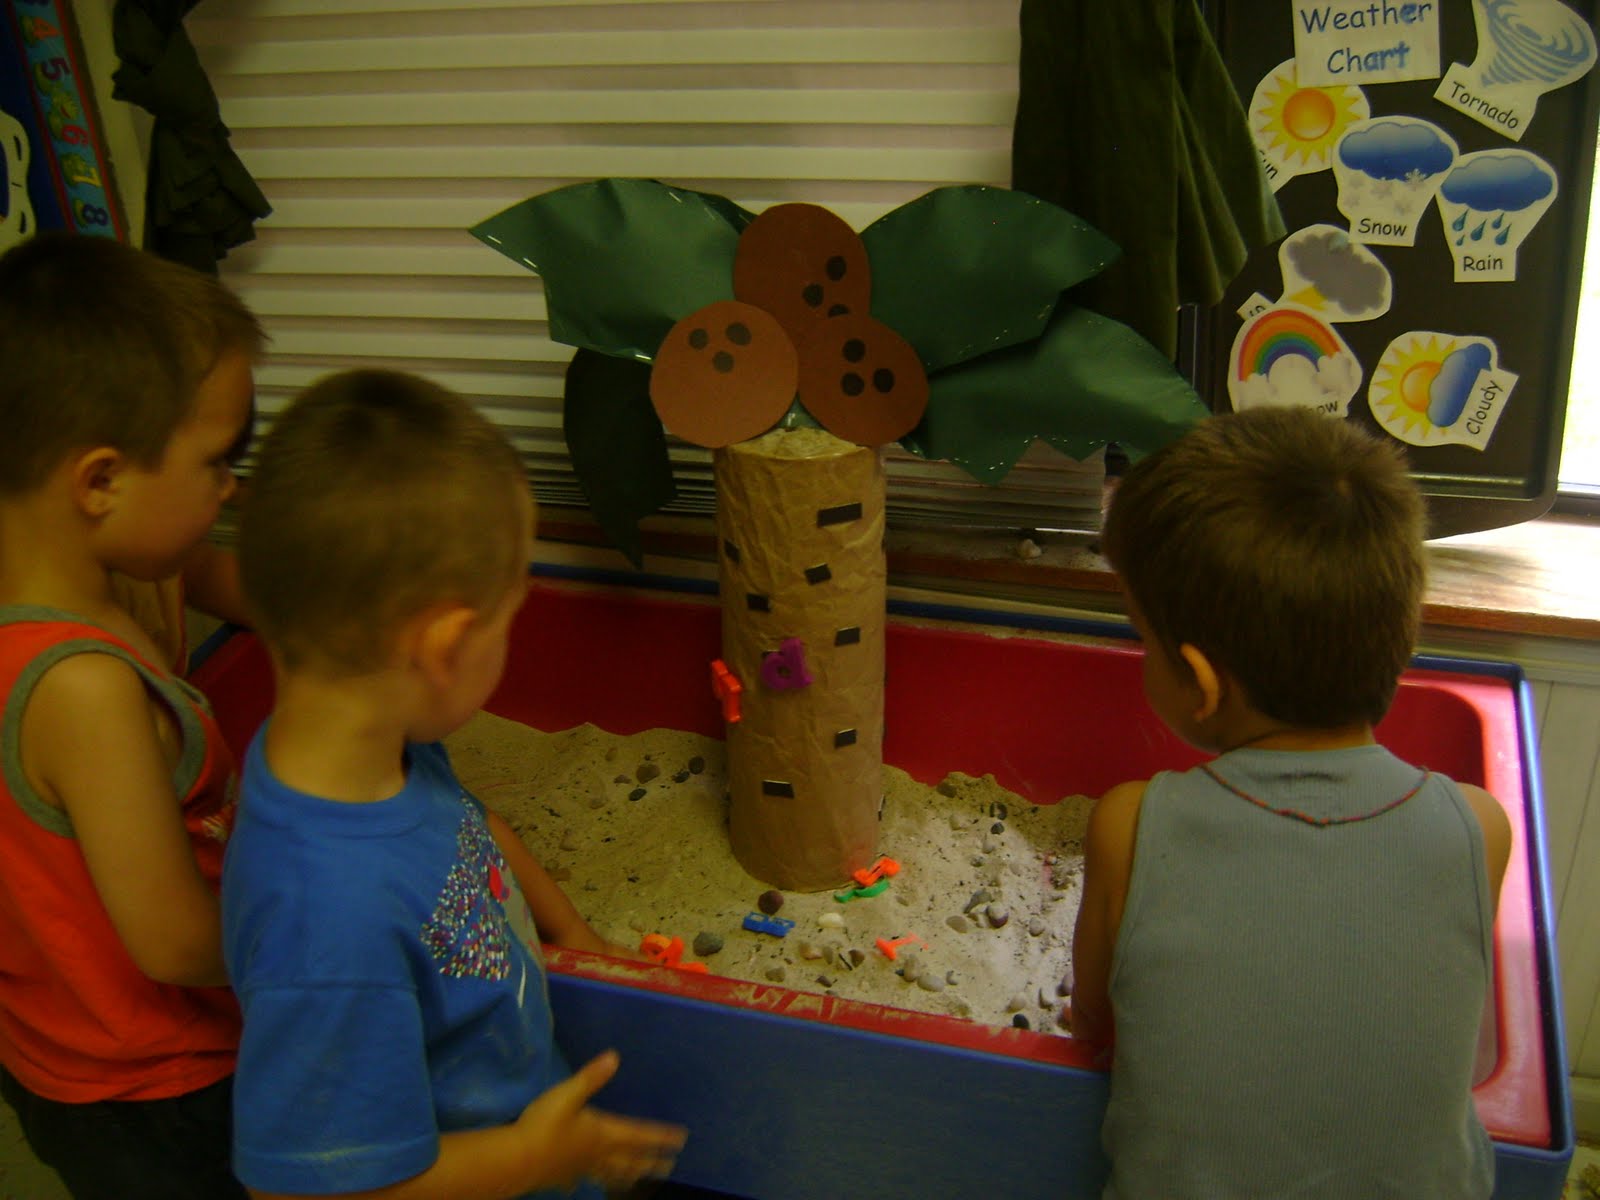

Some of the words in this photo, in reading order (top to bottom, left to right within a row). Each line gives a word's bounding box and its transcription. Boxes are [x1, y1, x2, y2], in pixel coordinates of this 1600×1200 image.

[32, 17, 61, 40] 4
[1300, 2, 1432, 34] Weather
[42, 57, 70, 80] 5
[1327, 40, 1410, 74] Chart
[1451, 81, 1519, 130] Tornado
[61, 124, 89, 146] 6
[72, 167, 101, 187] 7
[82, 203, 109, 226] 8
[1358, 218, 1408, 237] Snow
[1463, 255, 1504, 272] Rain
[1465, 379, 1504, 436] Cloudy
